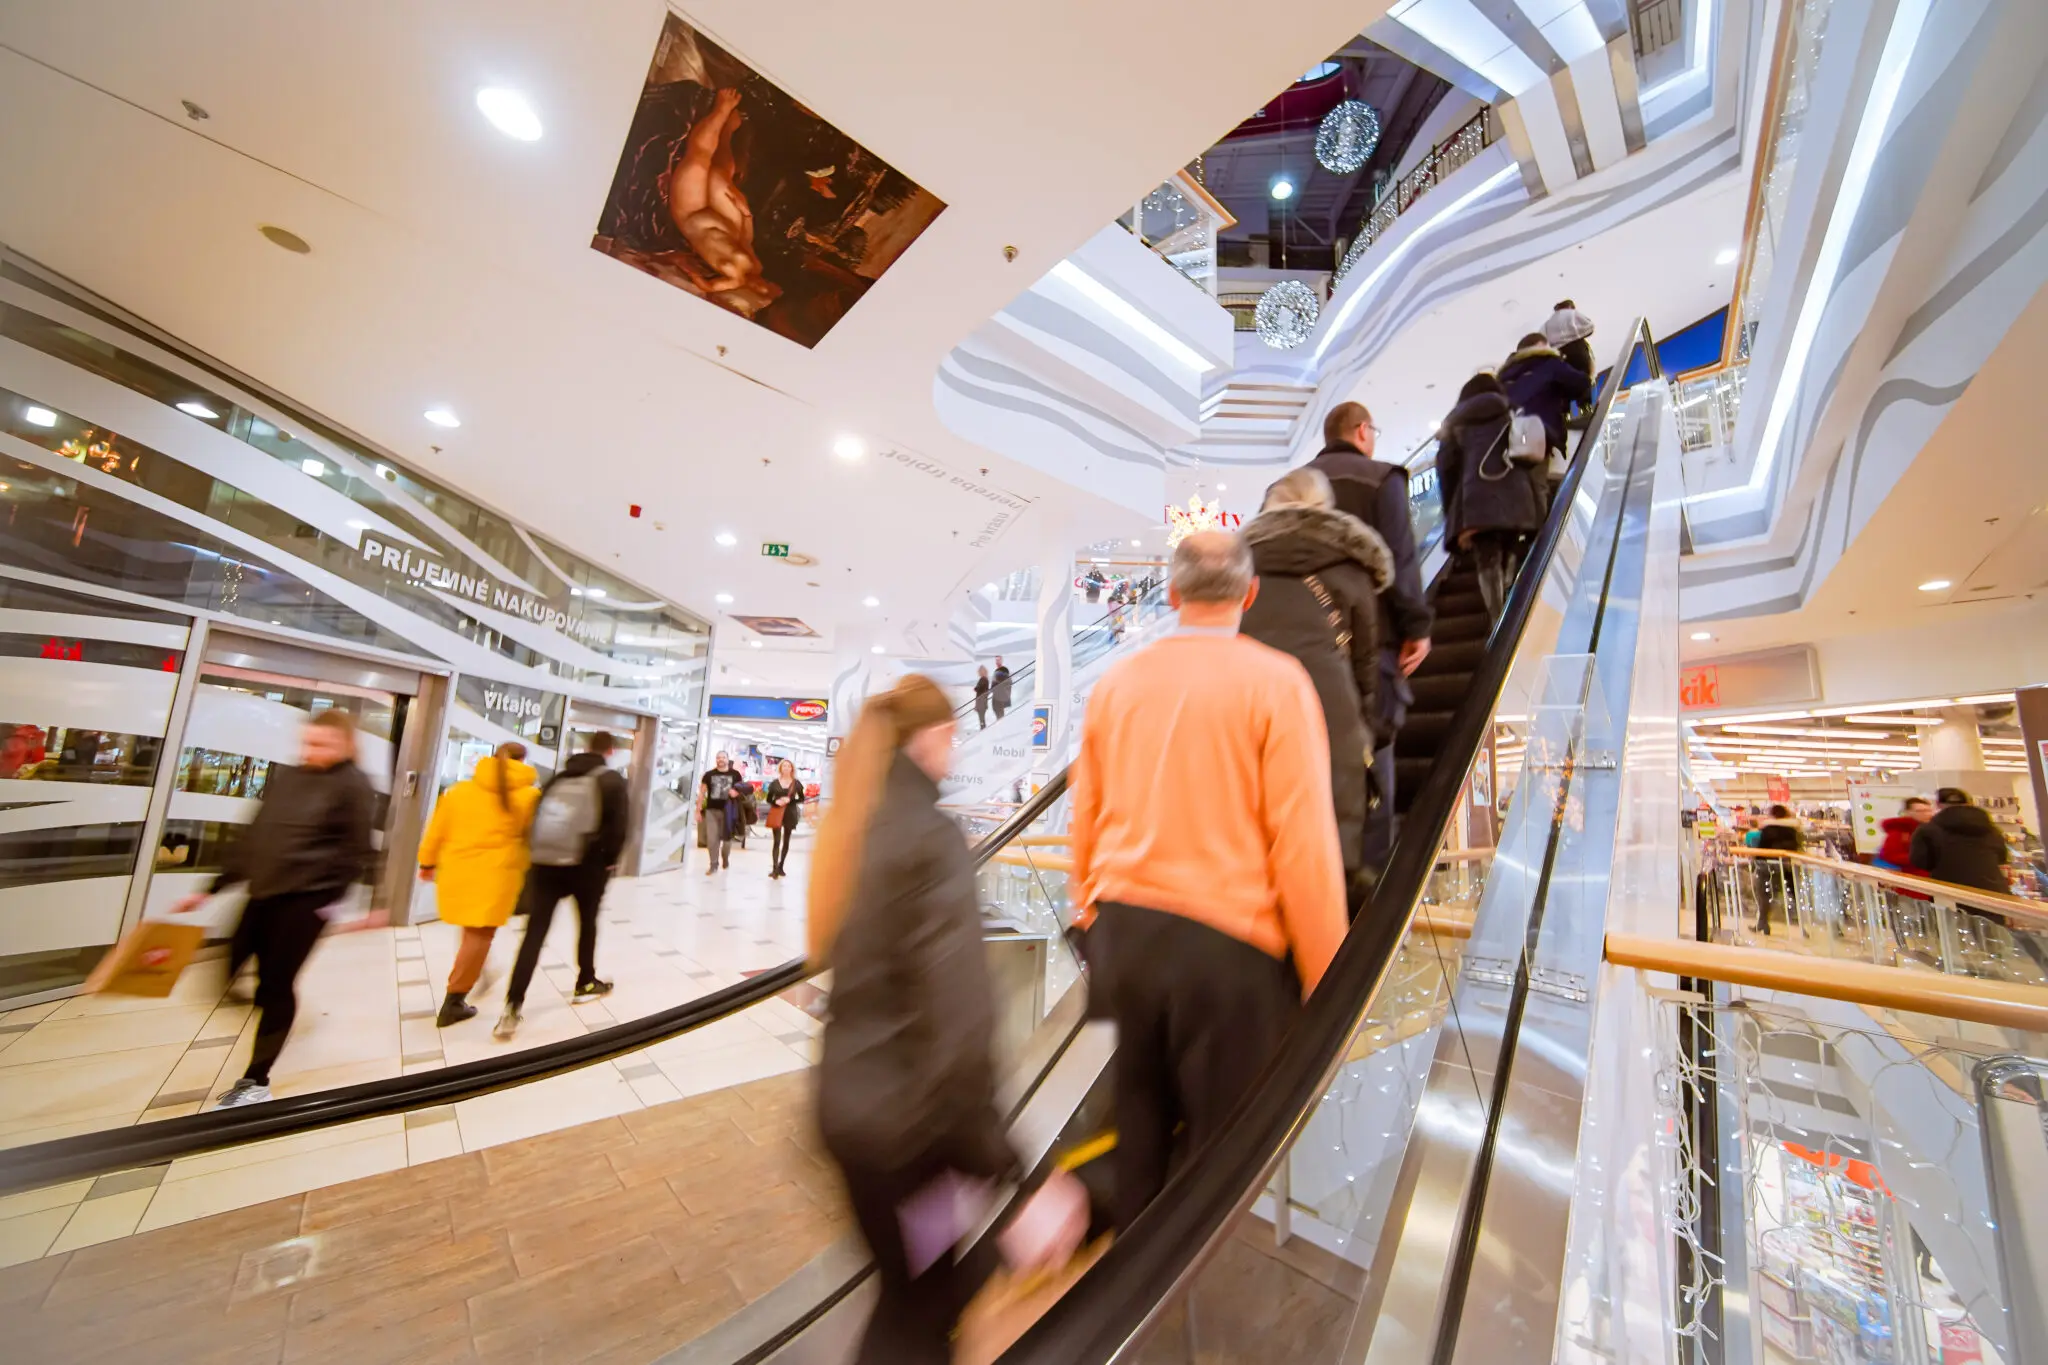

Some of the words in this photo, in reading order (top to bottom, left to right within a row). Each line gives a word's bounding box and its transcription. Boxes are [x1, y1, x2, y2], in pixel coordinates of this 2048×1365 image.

[950, 476, 1023, 510] netreba
[363, 539, 490, 601] PRÍJEMNÉ
[484, 689, 542, 719] Vitajte
[1680, 672, 1717, 706] kik
[992, 745, 1026, 758] Mobil
